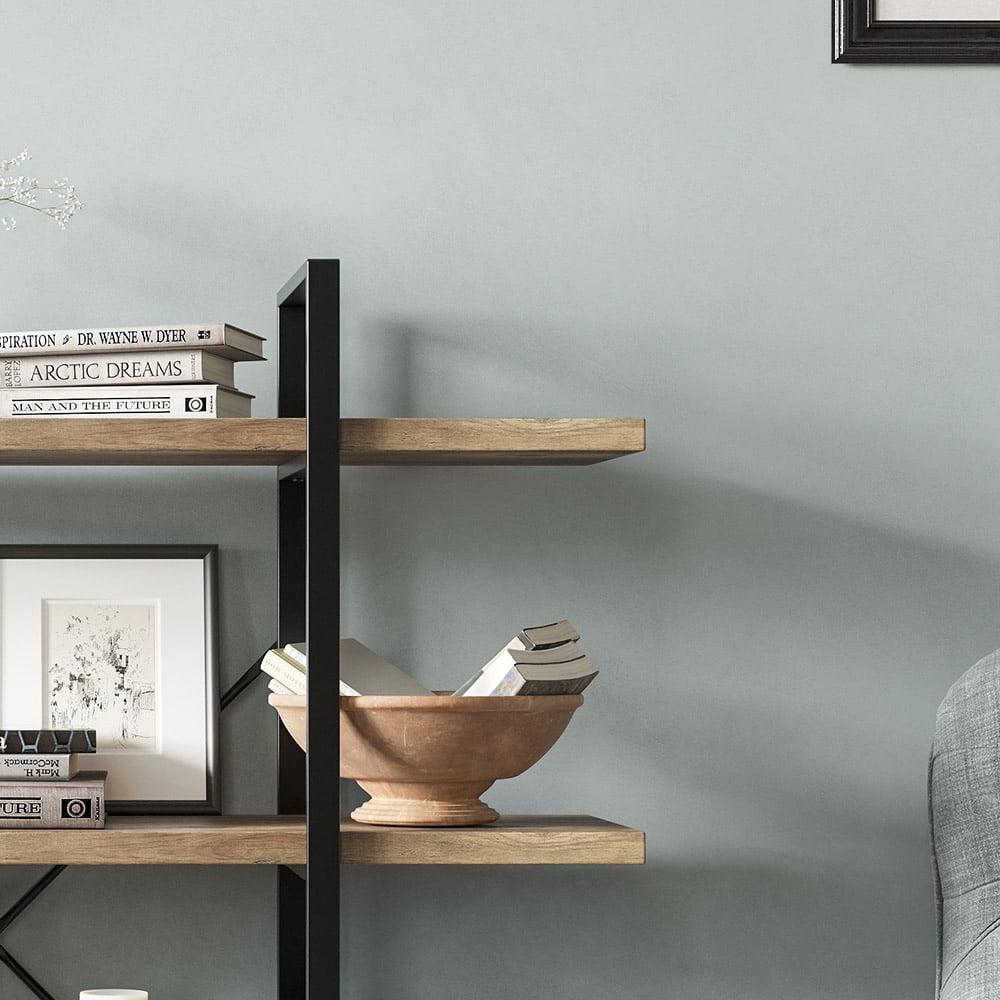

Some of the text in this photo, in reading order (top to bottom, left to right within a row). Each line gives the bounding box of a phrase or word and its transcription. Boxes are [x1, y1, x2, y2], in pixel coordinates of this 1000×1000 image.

[77, 331, 97, 346] DR.
[98, 330, 139, 345] WAYNE
[139, 330, 154, 344] W.
[155, 328, 187, 344] DYER
[4, 360, 13, 387] BARRY
[13, 360, 22, 387] LOPEZ
[30, 362, 99, 382] ARCTIC
[106, 360, 182, 380] DREAMS
[12, 400, 171, 412] MAN AND THE FUTURE
[3, 758, 60, 768] McCormack
[23, 768, 60, 777] Mark H.
